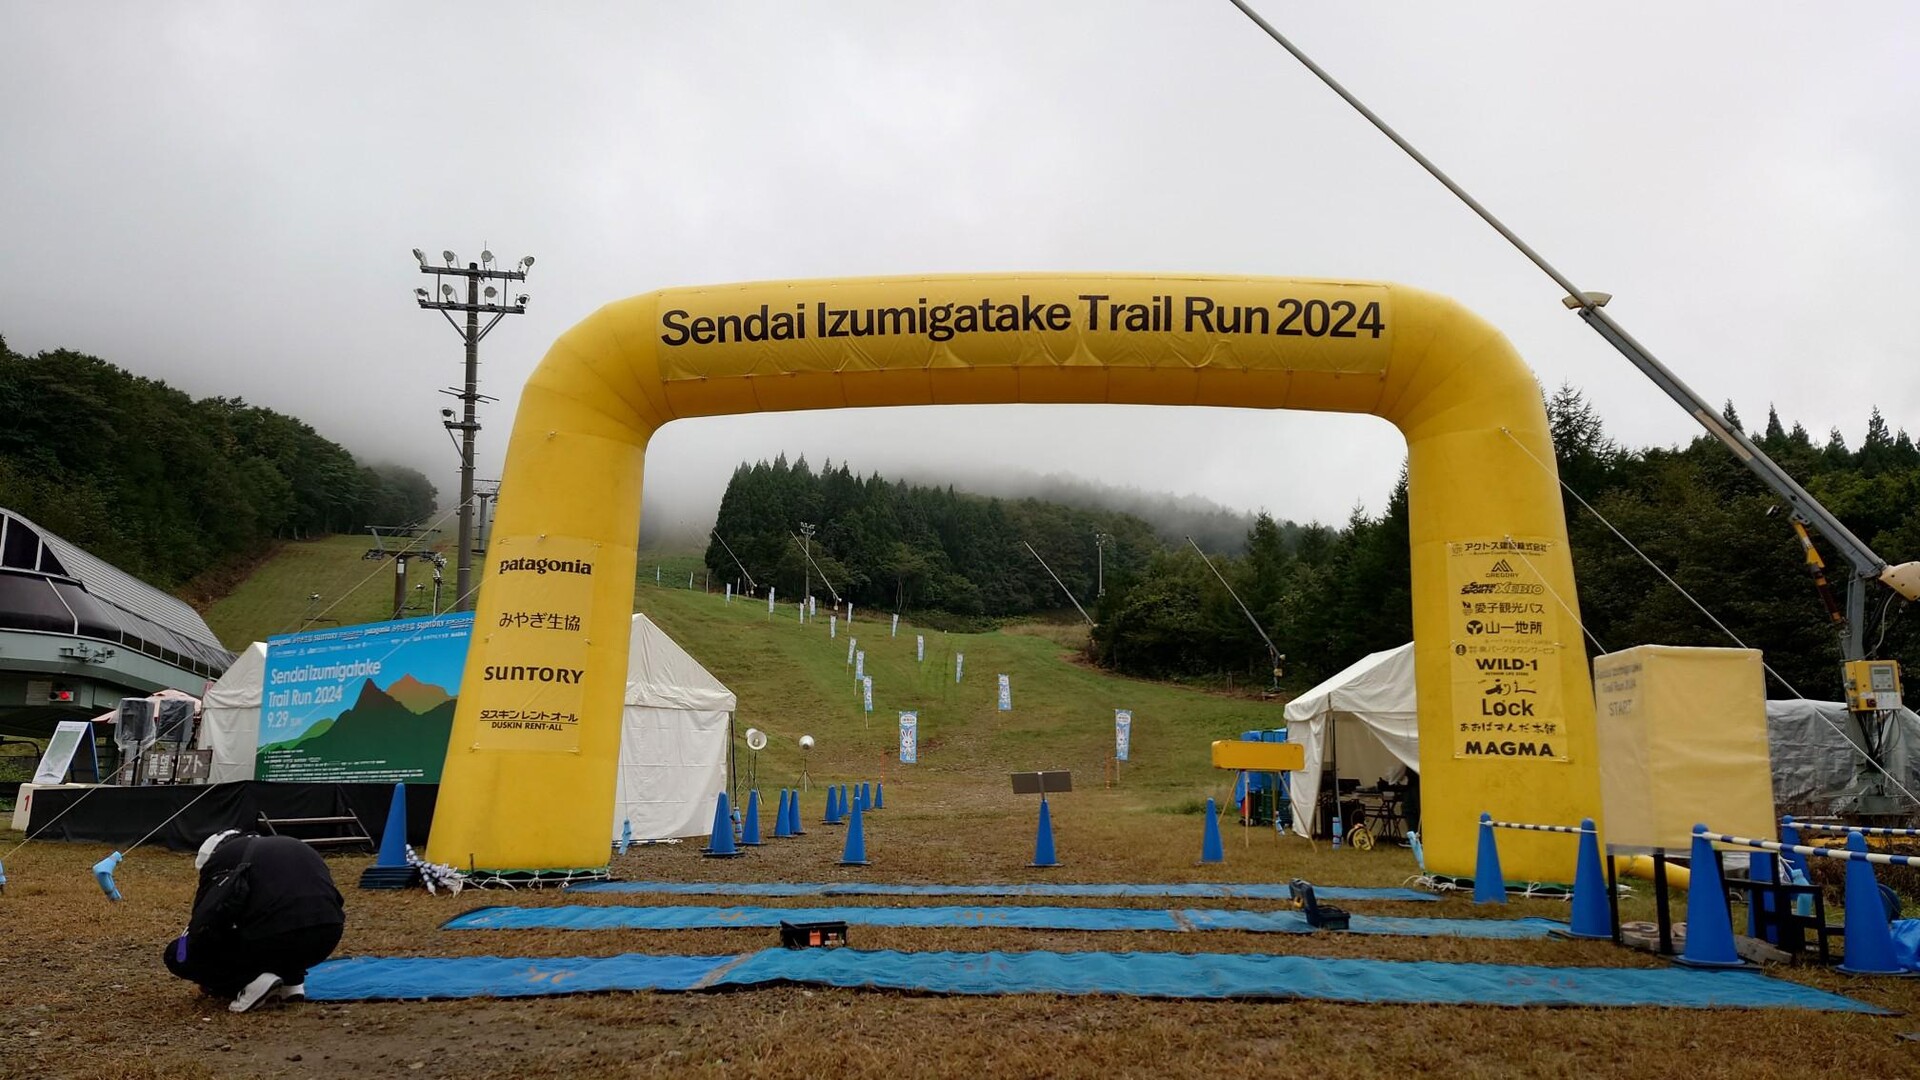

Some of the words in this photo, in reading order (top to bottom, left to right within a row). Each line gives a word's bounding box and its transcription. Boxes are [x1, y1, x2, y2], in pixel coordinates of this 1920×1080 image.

[661, 303, 806, 346] Sendai
[818, 294, 1072, 341] Izumigatake
[1078, 295, 1173, 333] Trail
[1185, 297, 1270, 335] Run
[1277, 297, 1386, 339] 2024
[499, 557, 592, 575] patagonia
[1460, 587, 1495, 595] SPORTS
[1474, 602, 1545, 615] 愛子観光バス
[499, 611, 581, 631] みやぎ生協
[1485, 620, 1542, 635] 山一地所
[270, 664, 309, 685] Sendai
[308, 659, 382, 683] Izumigatake
[1475, 658, 1538, 671] WILD-1
[483, 665, 584, 684] SUNTORY
[268, 689, 289, 707] Trail
[292, 689, 312, 706] Run
[314, 685, 343, 704] 2024
[1481, 698, 1534, 717] Lock
[267, 711, 289, 728] 9.29
[491, 721, 523, 729] DUSKIN
[1465, 740, 1555, 757] MAGMA
[24, 794, 31, 812] 1
